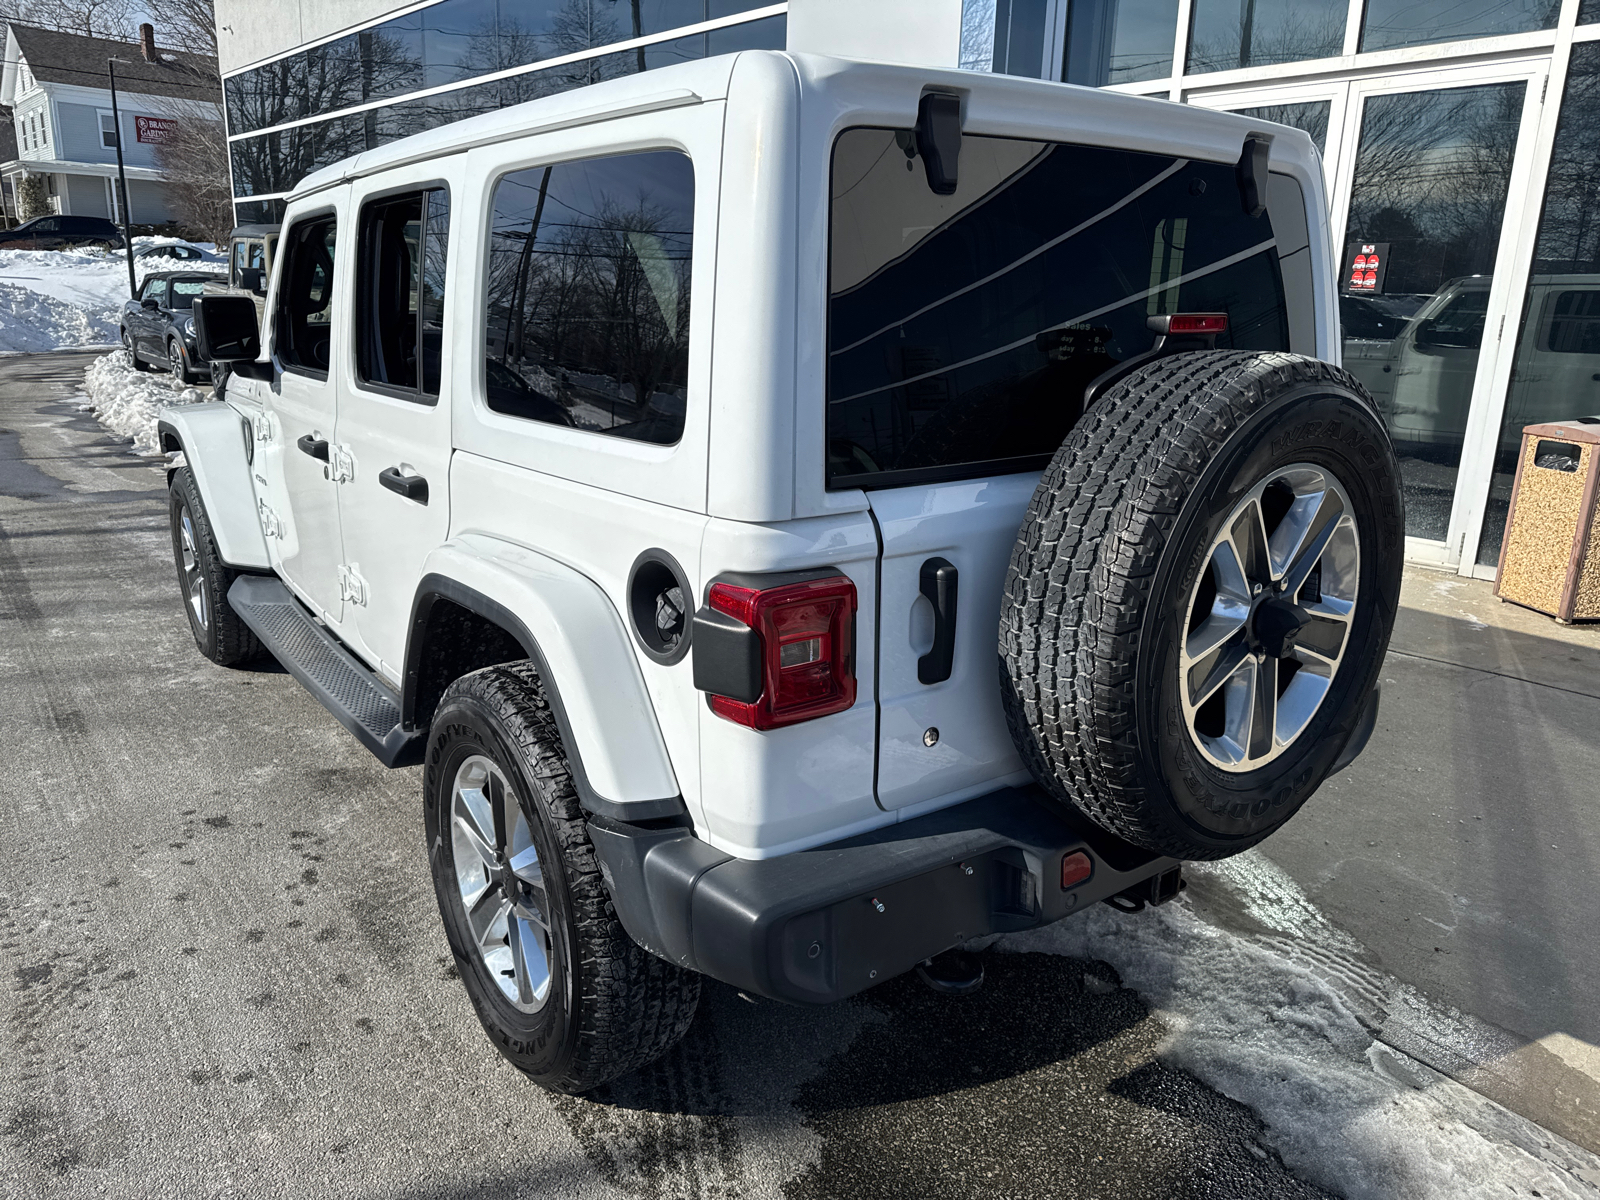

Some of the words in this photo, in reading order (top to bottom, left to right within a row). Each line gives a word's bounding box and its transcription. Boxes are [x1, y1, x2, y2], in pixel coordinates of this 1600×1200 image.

[1065, 321, 1091, 331] Sales
[1271, 419, 1398, 550] WRANGLER
[1181, 537, 1206, 590] Kevlar
[1166, 705, 1314, 820] GOODYEAR
